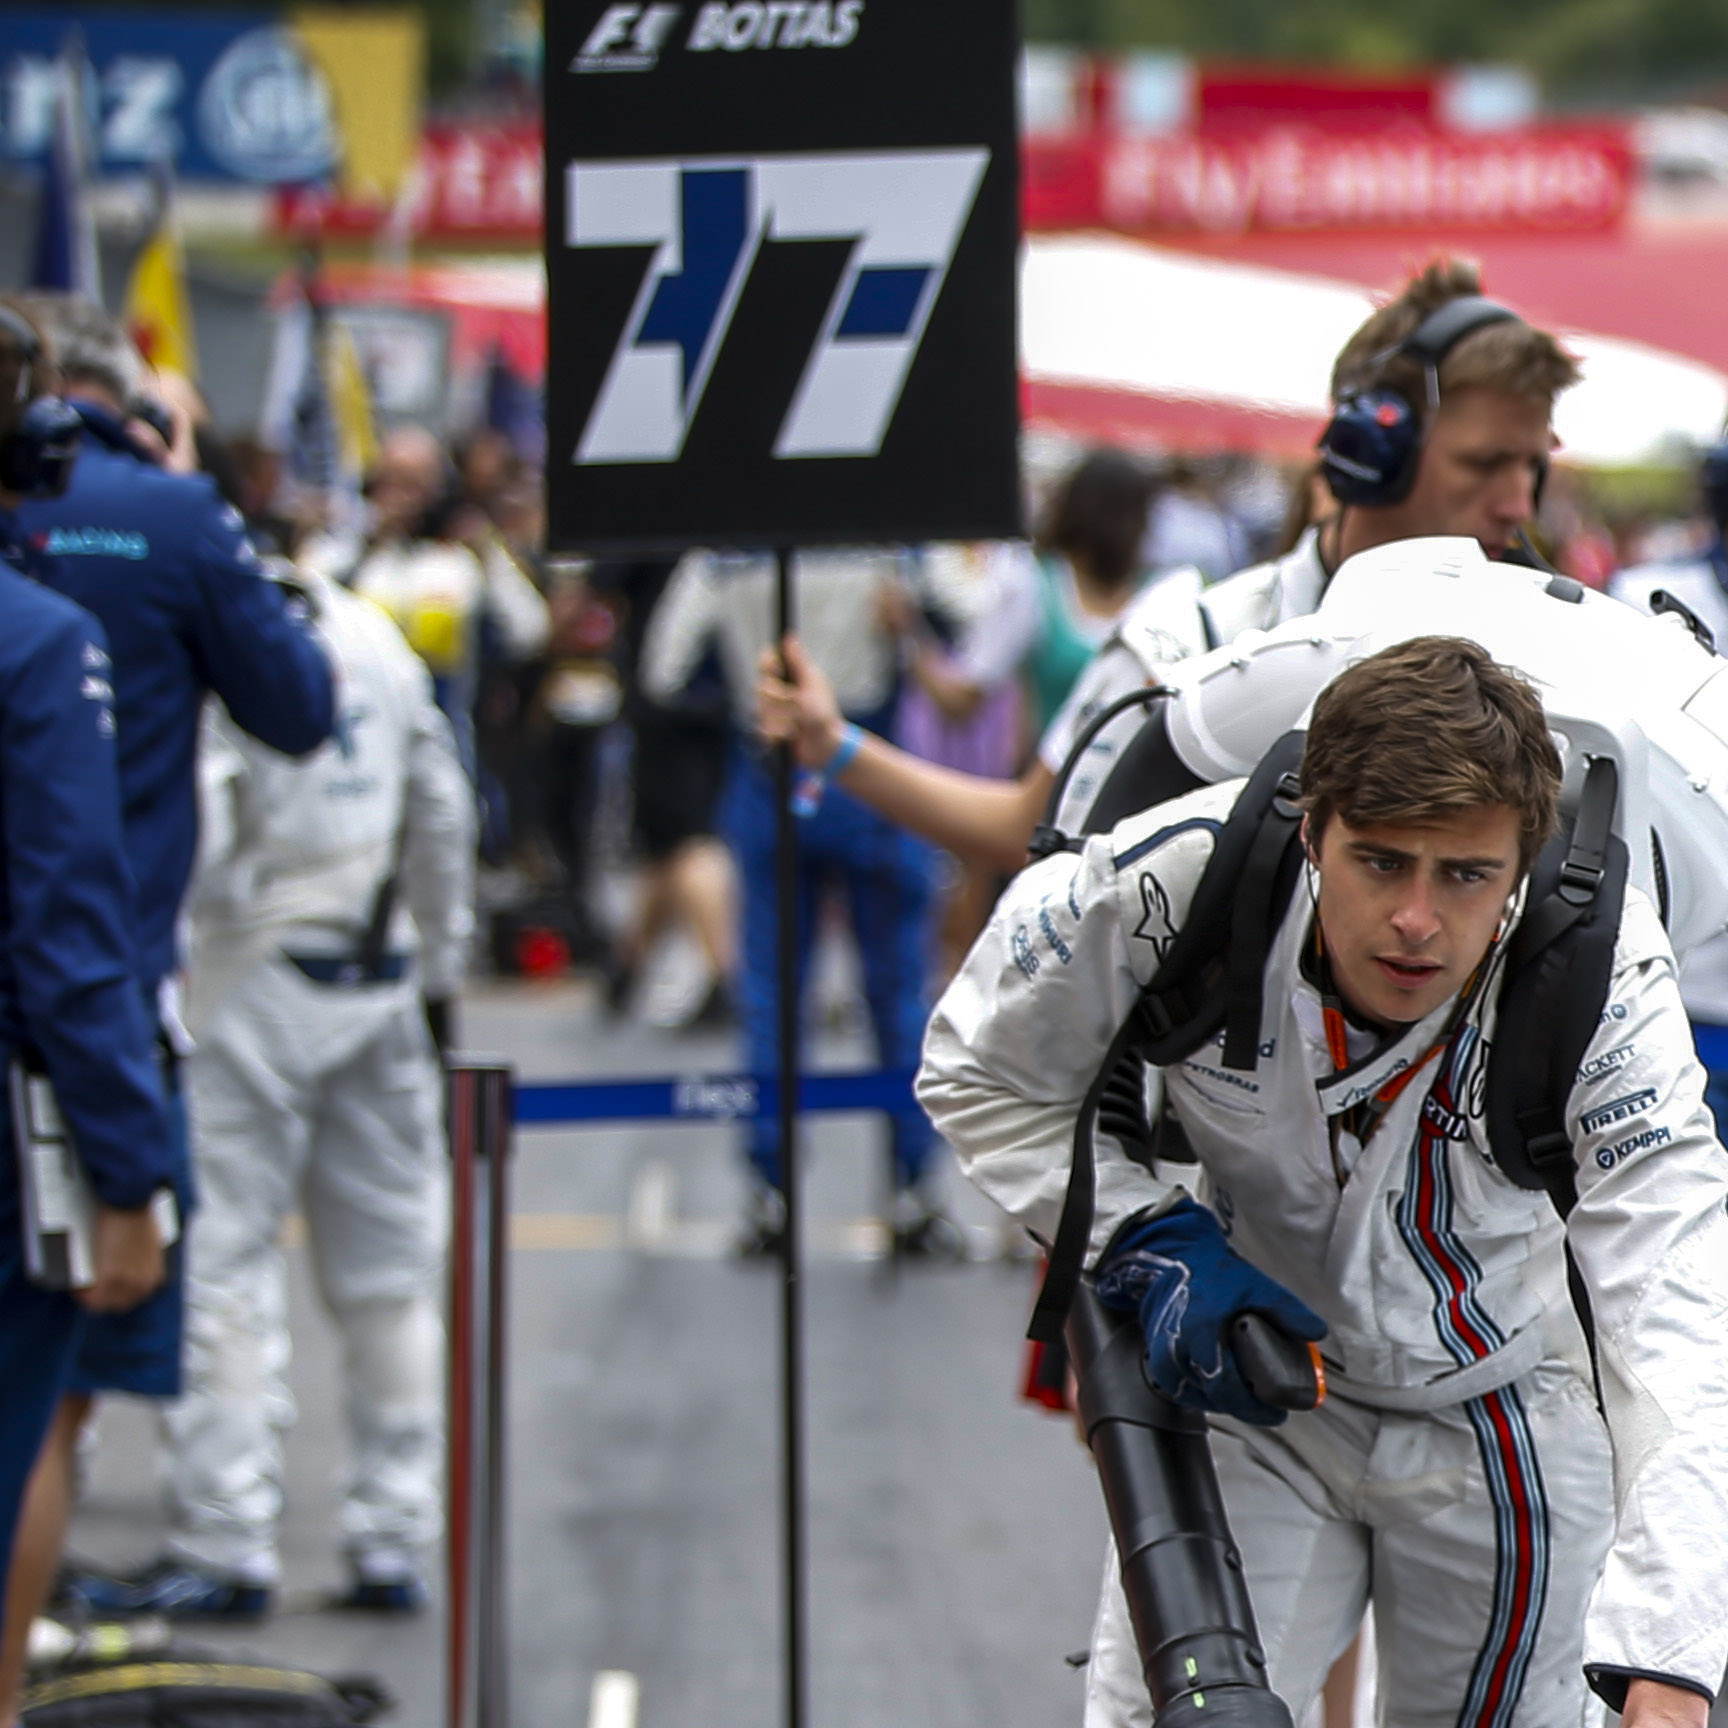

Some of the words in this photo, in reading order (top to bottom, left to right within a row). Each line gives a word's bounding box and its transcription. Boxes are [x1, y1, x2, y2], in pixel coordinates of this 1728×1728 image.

[685, 0, 867, 51] BOTTAS
[565, 145, 992, 465] 77
[1577, 1043, 1636, 1083] ACKETT
[1579, 1087, 1659, 1136] PIRELLI
[1614, 1125, 1672, 1160] KEMPPI
